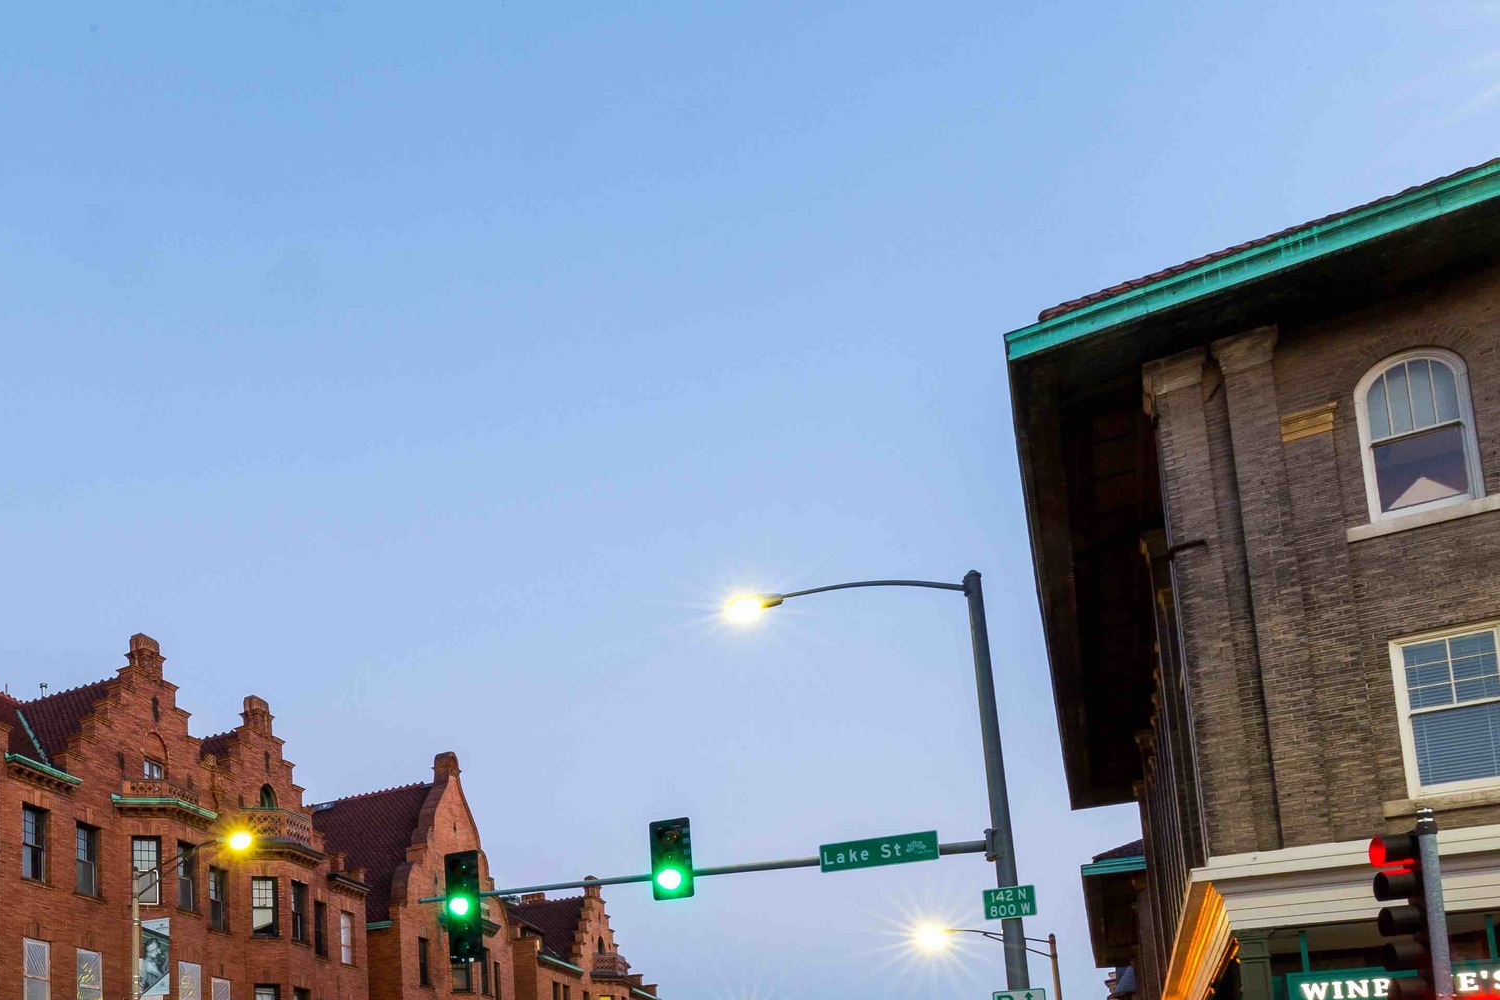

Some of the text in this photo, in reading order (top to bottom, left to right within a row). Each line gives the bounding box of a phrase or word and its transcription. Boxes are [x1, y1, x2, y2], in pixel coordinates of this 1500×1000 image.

[823, 843, 902, 866] Lake St
[990, 888, 1027, 903] 142 N
[990, 902, 1031, 918] 800 W
